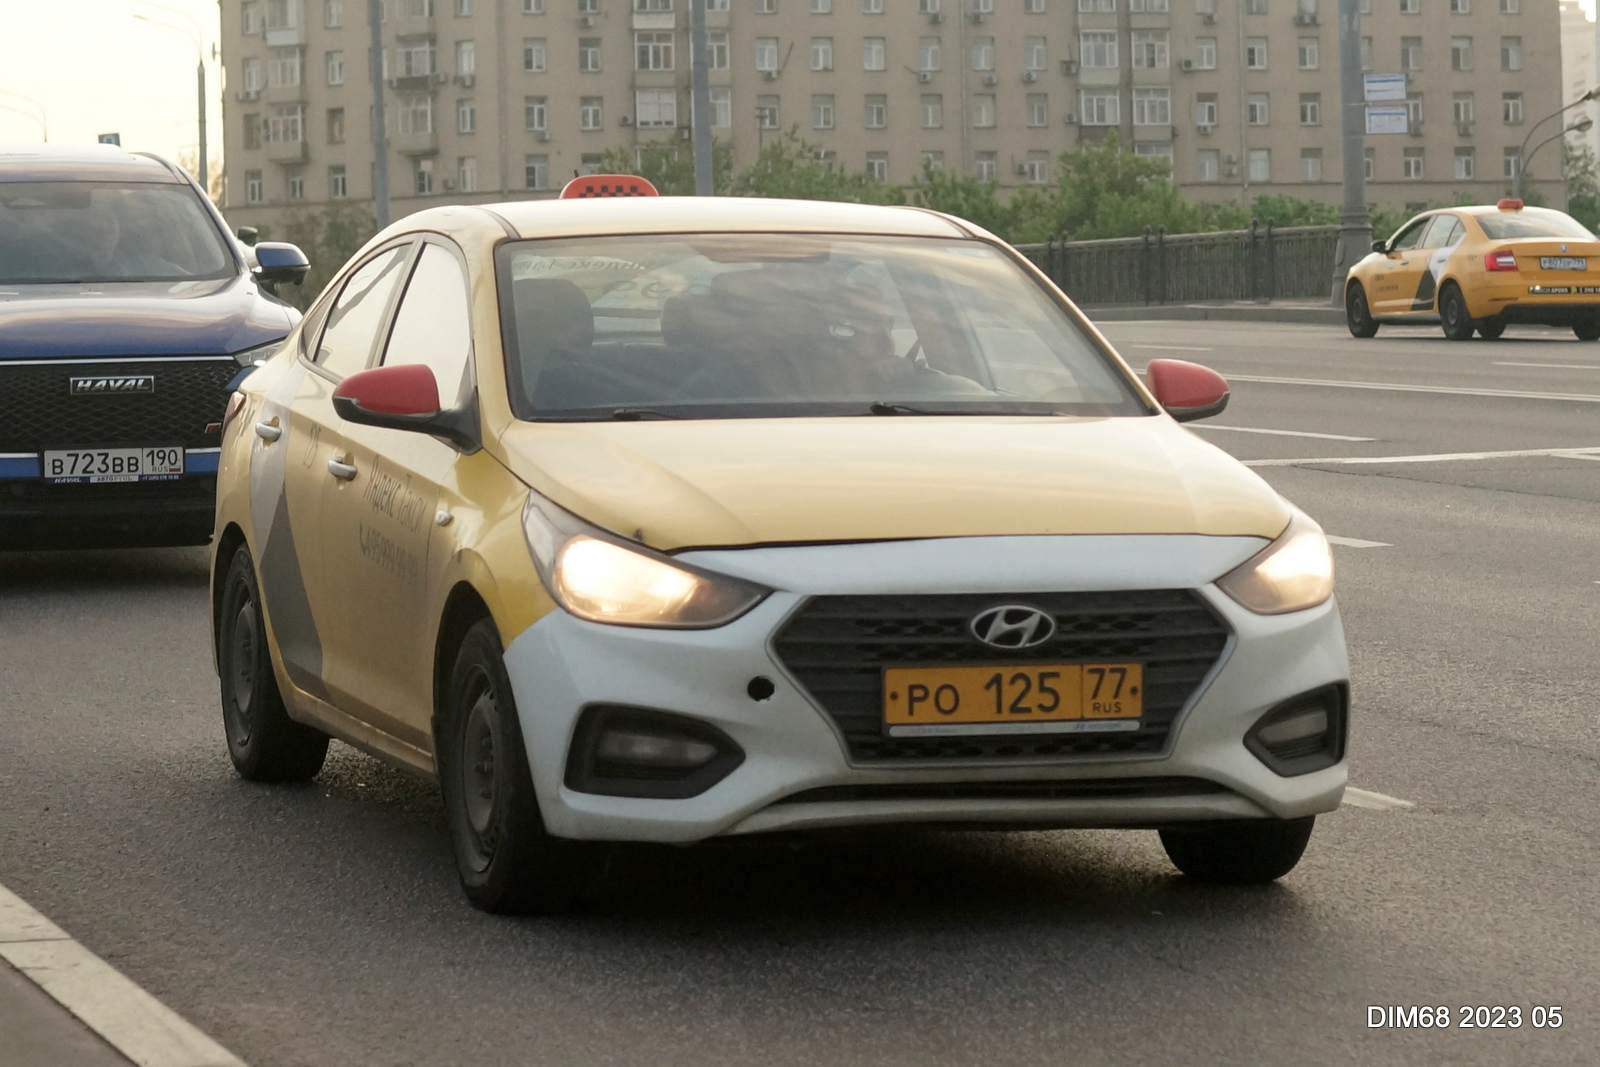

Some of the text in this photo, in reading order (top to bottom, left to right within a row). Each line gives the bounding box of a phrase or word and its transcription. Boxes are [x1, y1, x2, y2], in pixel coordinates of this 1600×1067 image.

[76, 379, 150, 391] HAVAL
[51, 449, 178, 475] В723ВВ 190
[363, 454, 428, 533] Яндекс Такси
[984, 672, 1060, 714] 125
[1087, 667, 1128, 700] 77
[1092, 702, 1122, 713] RUS
